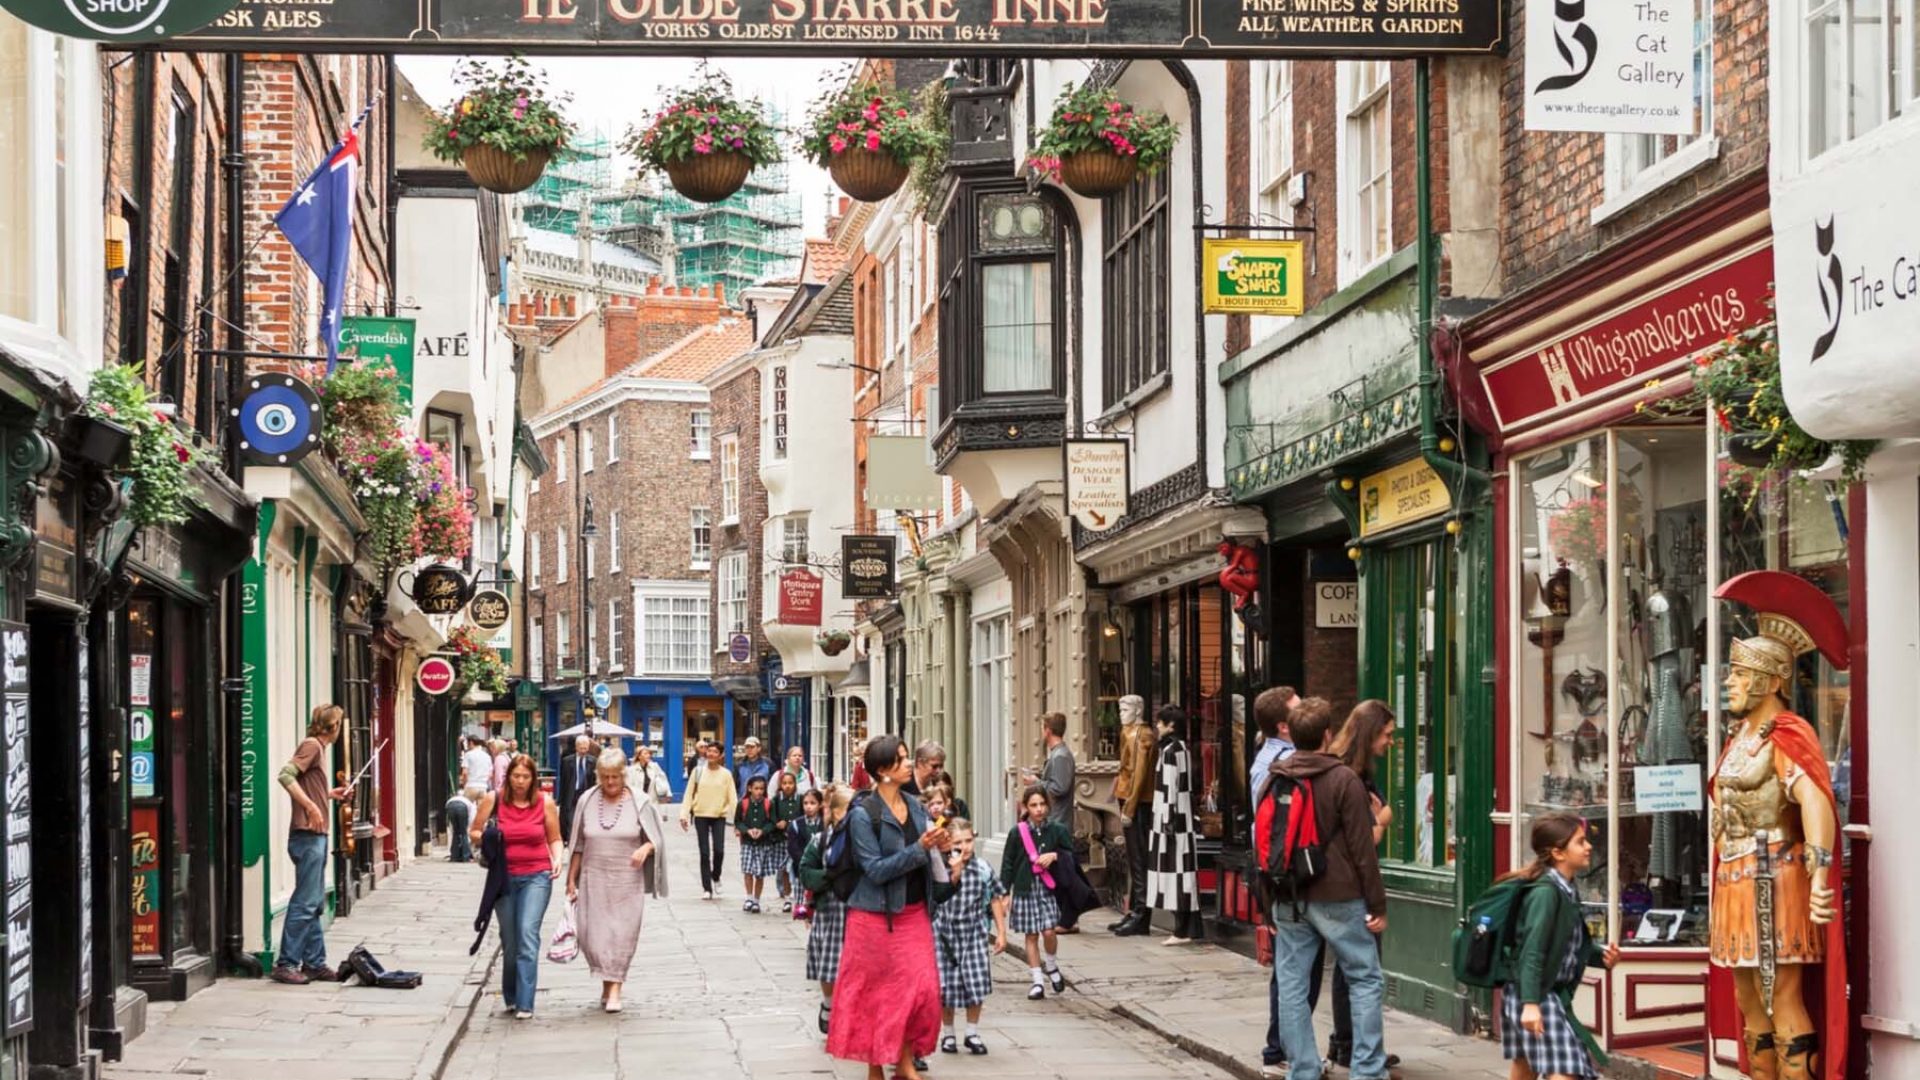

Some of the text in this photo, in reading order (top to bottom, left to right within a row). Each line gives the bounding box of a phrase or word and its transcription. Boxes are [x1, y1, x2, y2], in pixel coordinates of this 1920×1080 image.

[87, 0, 149, 12] SHOP
[1242, 0, 1460, 13] FINE WINES & SPIRITS
[1634, 3, 1669, 22] The
[263, 10, 325, 28] ALES
[1238, 16, 1463, 34] ALL WEATHER GARDEN
[641, 22, 1001, 41] YORK'S OLDEST LICENSED INN 1644
[1636, 34, 1667, 53] Cat
[1617, 62, 1684, 89] Gallery
[1544, 102, 1681, 119] www.thecatgallery.co.uk
[1226, 258, 1283, 281] SNAPPY
[1235, 277, 1280, 294] SNAPS
[1849, 256, 1920, 316] The Ca
[1252, 298, 1288, 306] PHOTOS
[338, 327, 408, 346] Cavendish
[1568, 287, 1746, 381] Whigmaleeries
[417, 331, 469, 357] AFÉ
[775, 365, 788, 451] GALLERY
[1072, 466, 1122, 475] DESIGNER
[1083, 476, 1112, 484] WEAR
[1078, 490, 1117, 499] Leather
[794, 571, 810, 580] The
[422, 596, 460, 611] CAFÉ
[241, 661, 257, 816] ANTIQUES CENTRE
